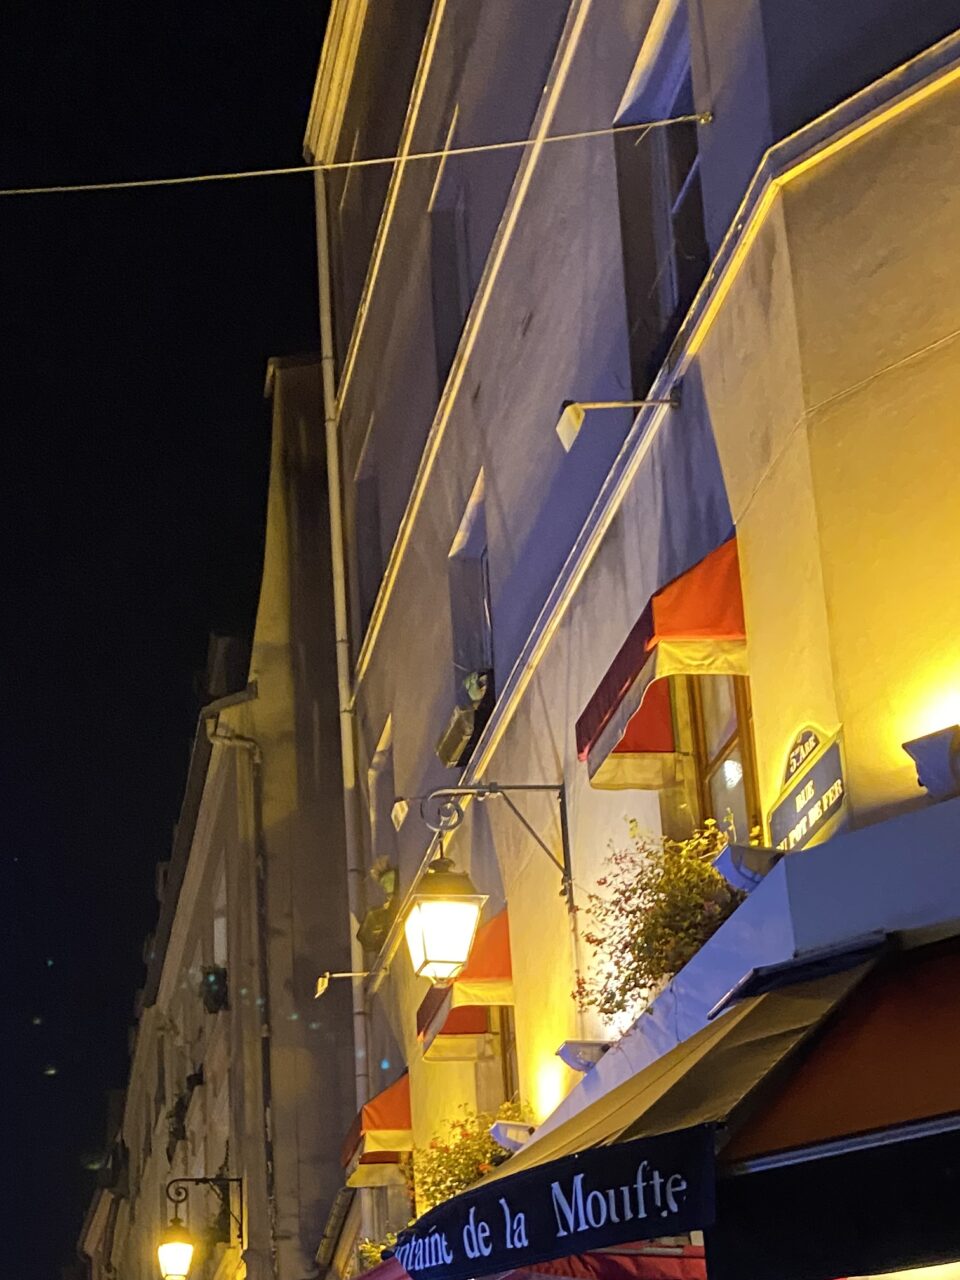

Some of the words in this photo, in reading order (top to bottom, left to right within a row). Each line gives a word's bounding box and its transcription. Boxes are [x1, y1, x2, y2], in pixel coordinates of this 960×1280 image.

[788, 815, 807, 849] POT
[808, 799, 823, 828] DE
[821, 779, 843, 812] FER
[795, 780, 815, 813] RUE
[462, 1206, 493, 1260] de
[499, 1198, 529, 1250] la
